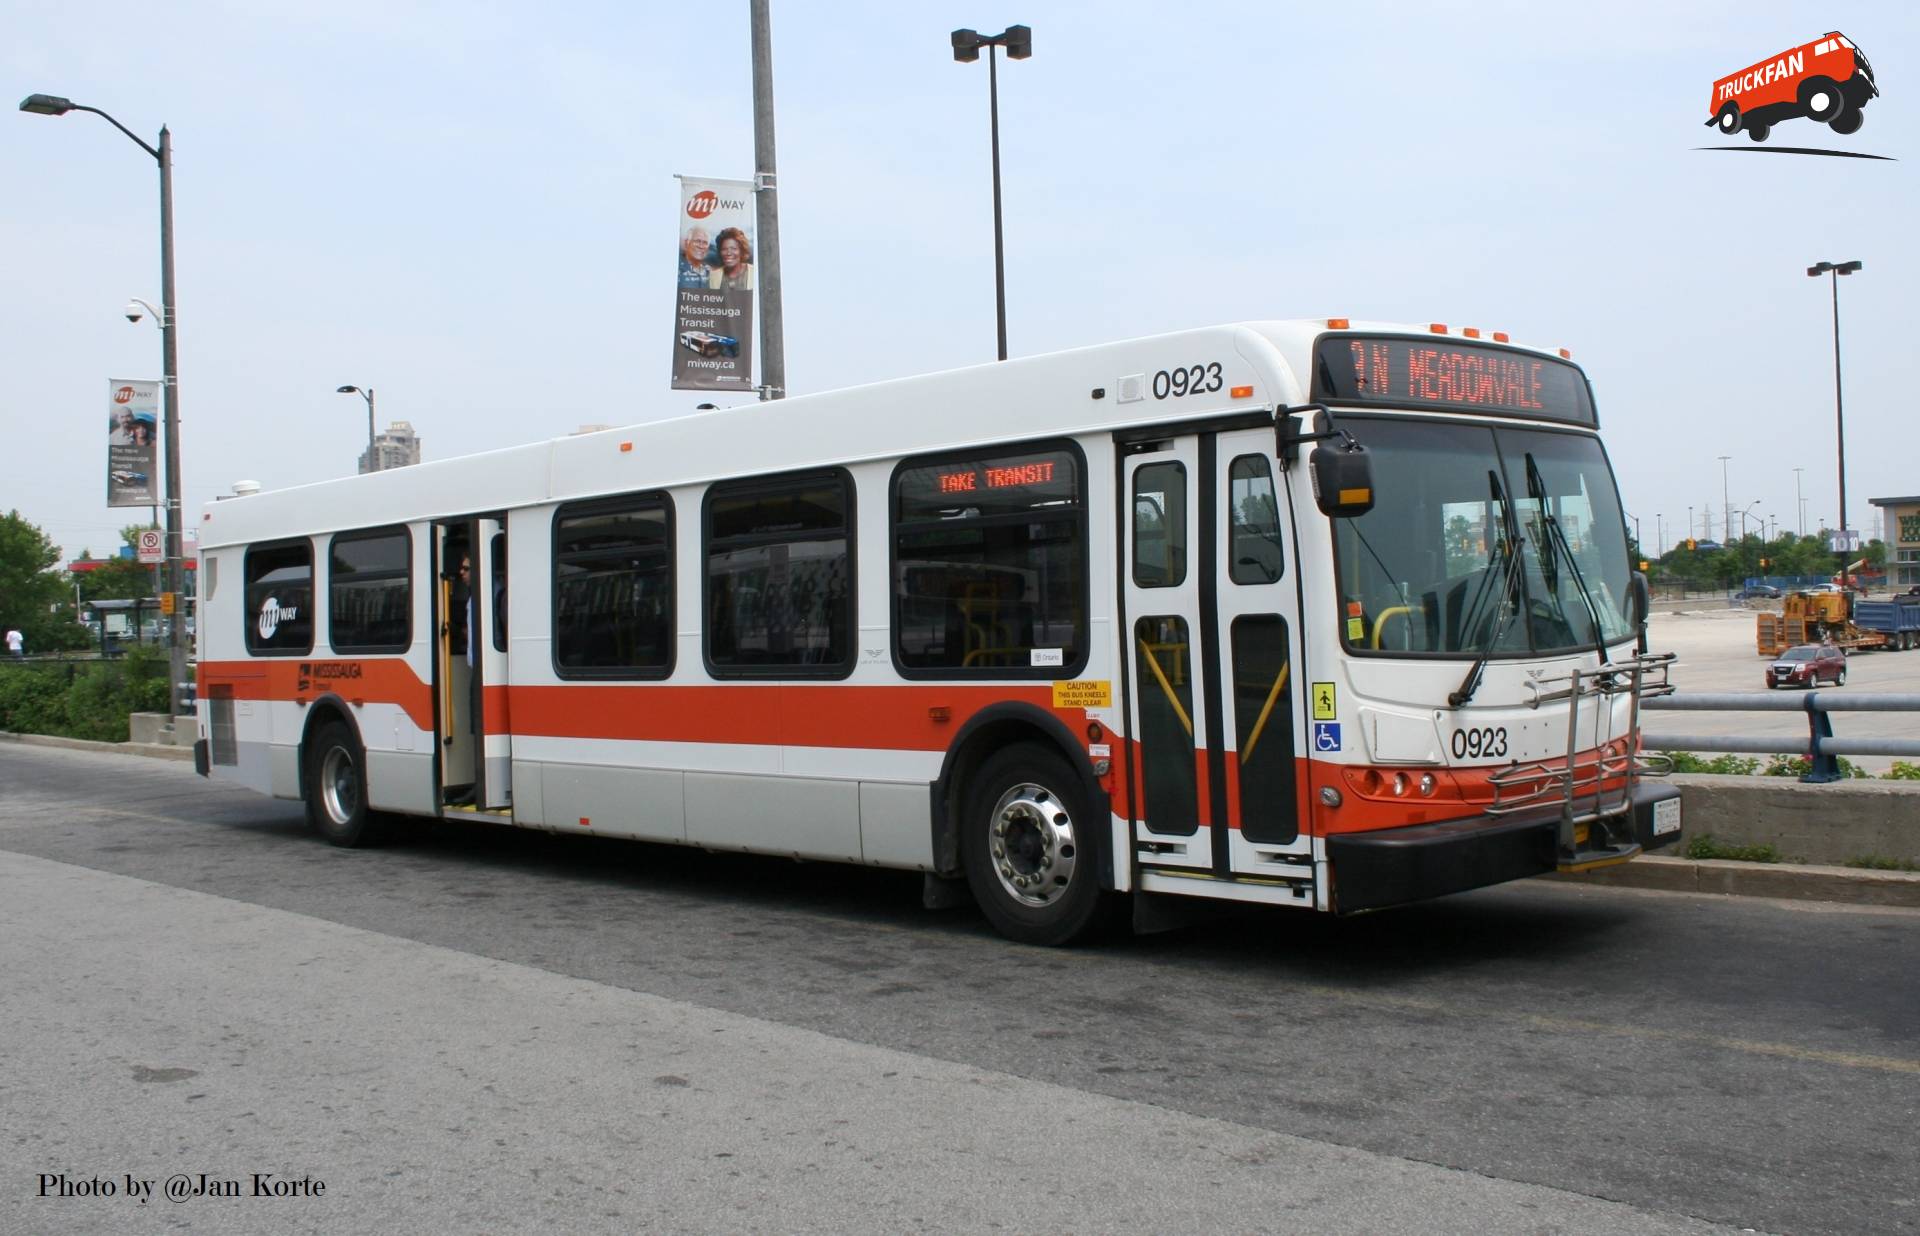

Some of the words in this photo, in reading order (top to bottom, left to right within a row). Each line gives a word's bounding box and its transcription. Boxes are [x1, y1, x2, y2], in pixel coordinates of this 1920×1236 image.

[720, 199, 745, 211] WAY
[681, 292, 700, 302] The
[703, 294, 724, 303] new
[680, 305, 741, 318] Mississauga
[680, 317, 715, 328] Transit
[687, 359, 735, 370] miway.ca
[1153, 362, 1223, 400] 0923
[1409, 348, 1542, 408] MEADOWVALE
[939, 473, 976, 493] TAKE
[985, 463, 1054, 488] TRANSIT
[1830, 537, 1848, 552] 10
[1849, 536, 1859, 552] 10
[279, 607, 297, 620] WAY
[1066, 682, 1097, 690] CAUTION
[1451, 727, 1508, 759] 0923
